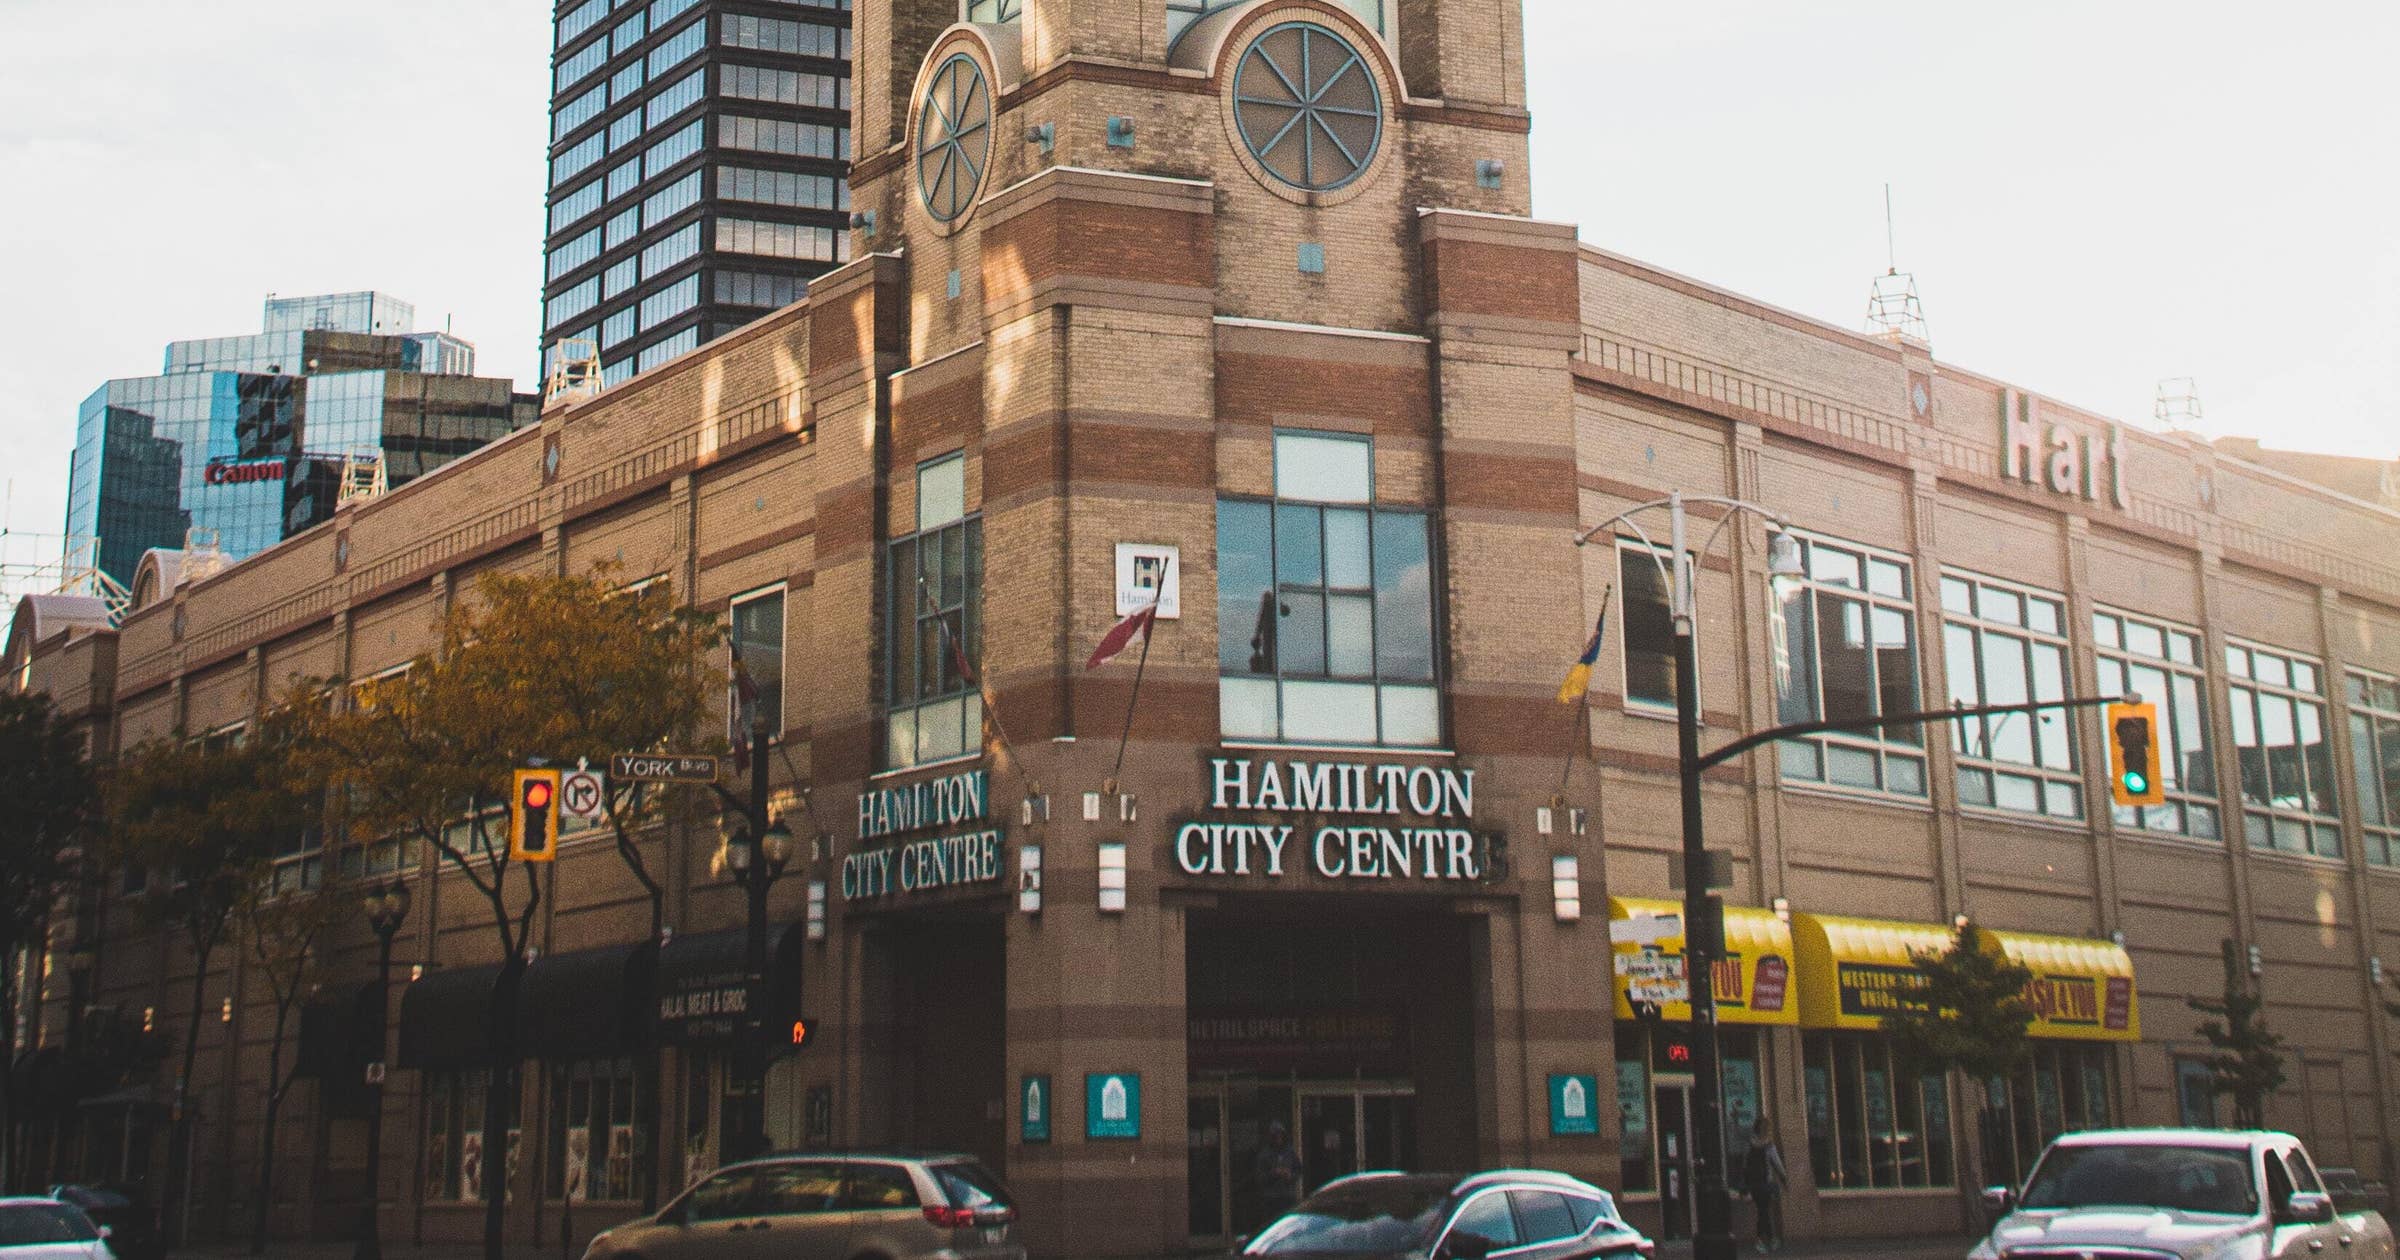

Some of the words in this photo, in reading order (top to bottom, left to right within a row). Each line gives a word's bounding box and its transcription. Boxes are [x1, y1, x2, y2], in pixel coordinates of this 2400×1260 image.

[204, 461, 284, 483] Canon
[1999, 388, 2129, 510] Hart
[621, 757, 674, 776] YORK
[1211, 759, 1474, 818] HAMILTON
[858, 770, 984, 839] HAMILTON
[842, 849, 893, 900] CITY
[901, 830, 999, 892] CENTRE
[1176, 823, 1293, 876] CITY
